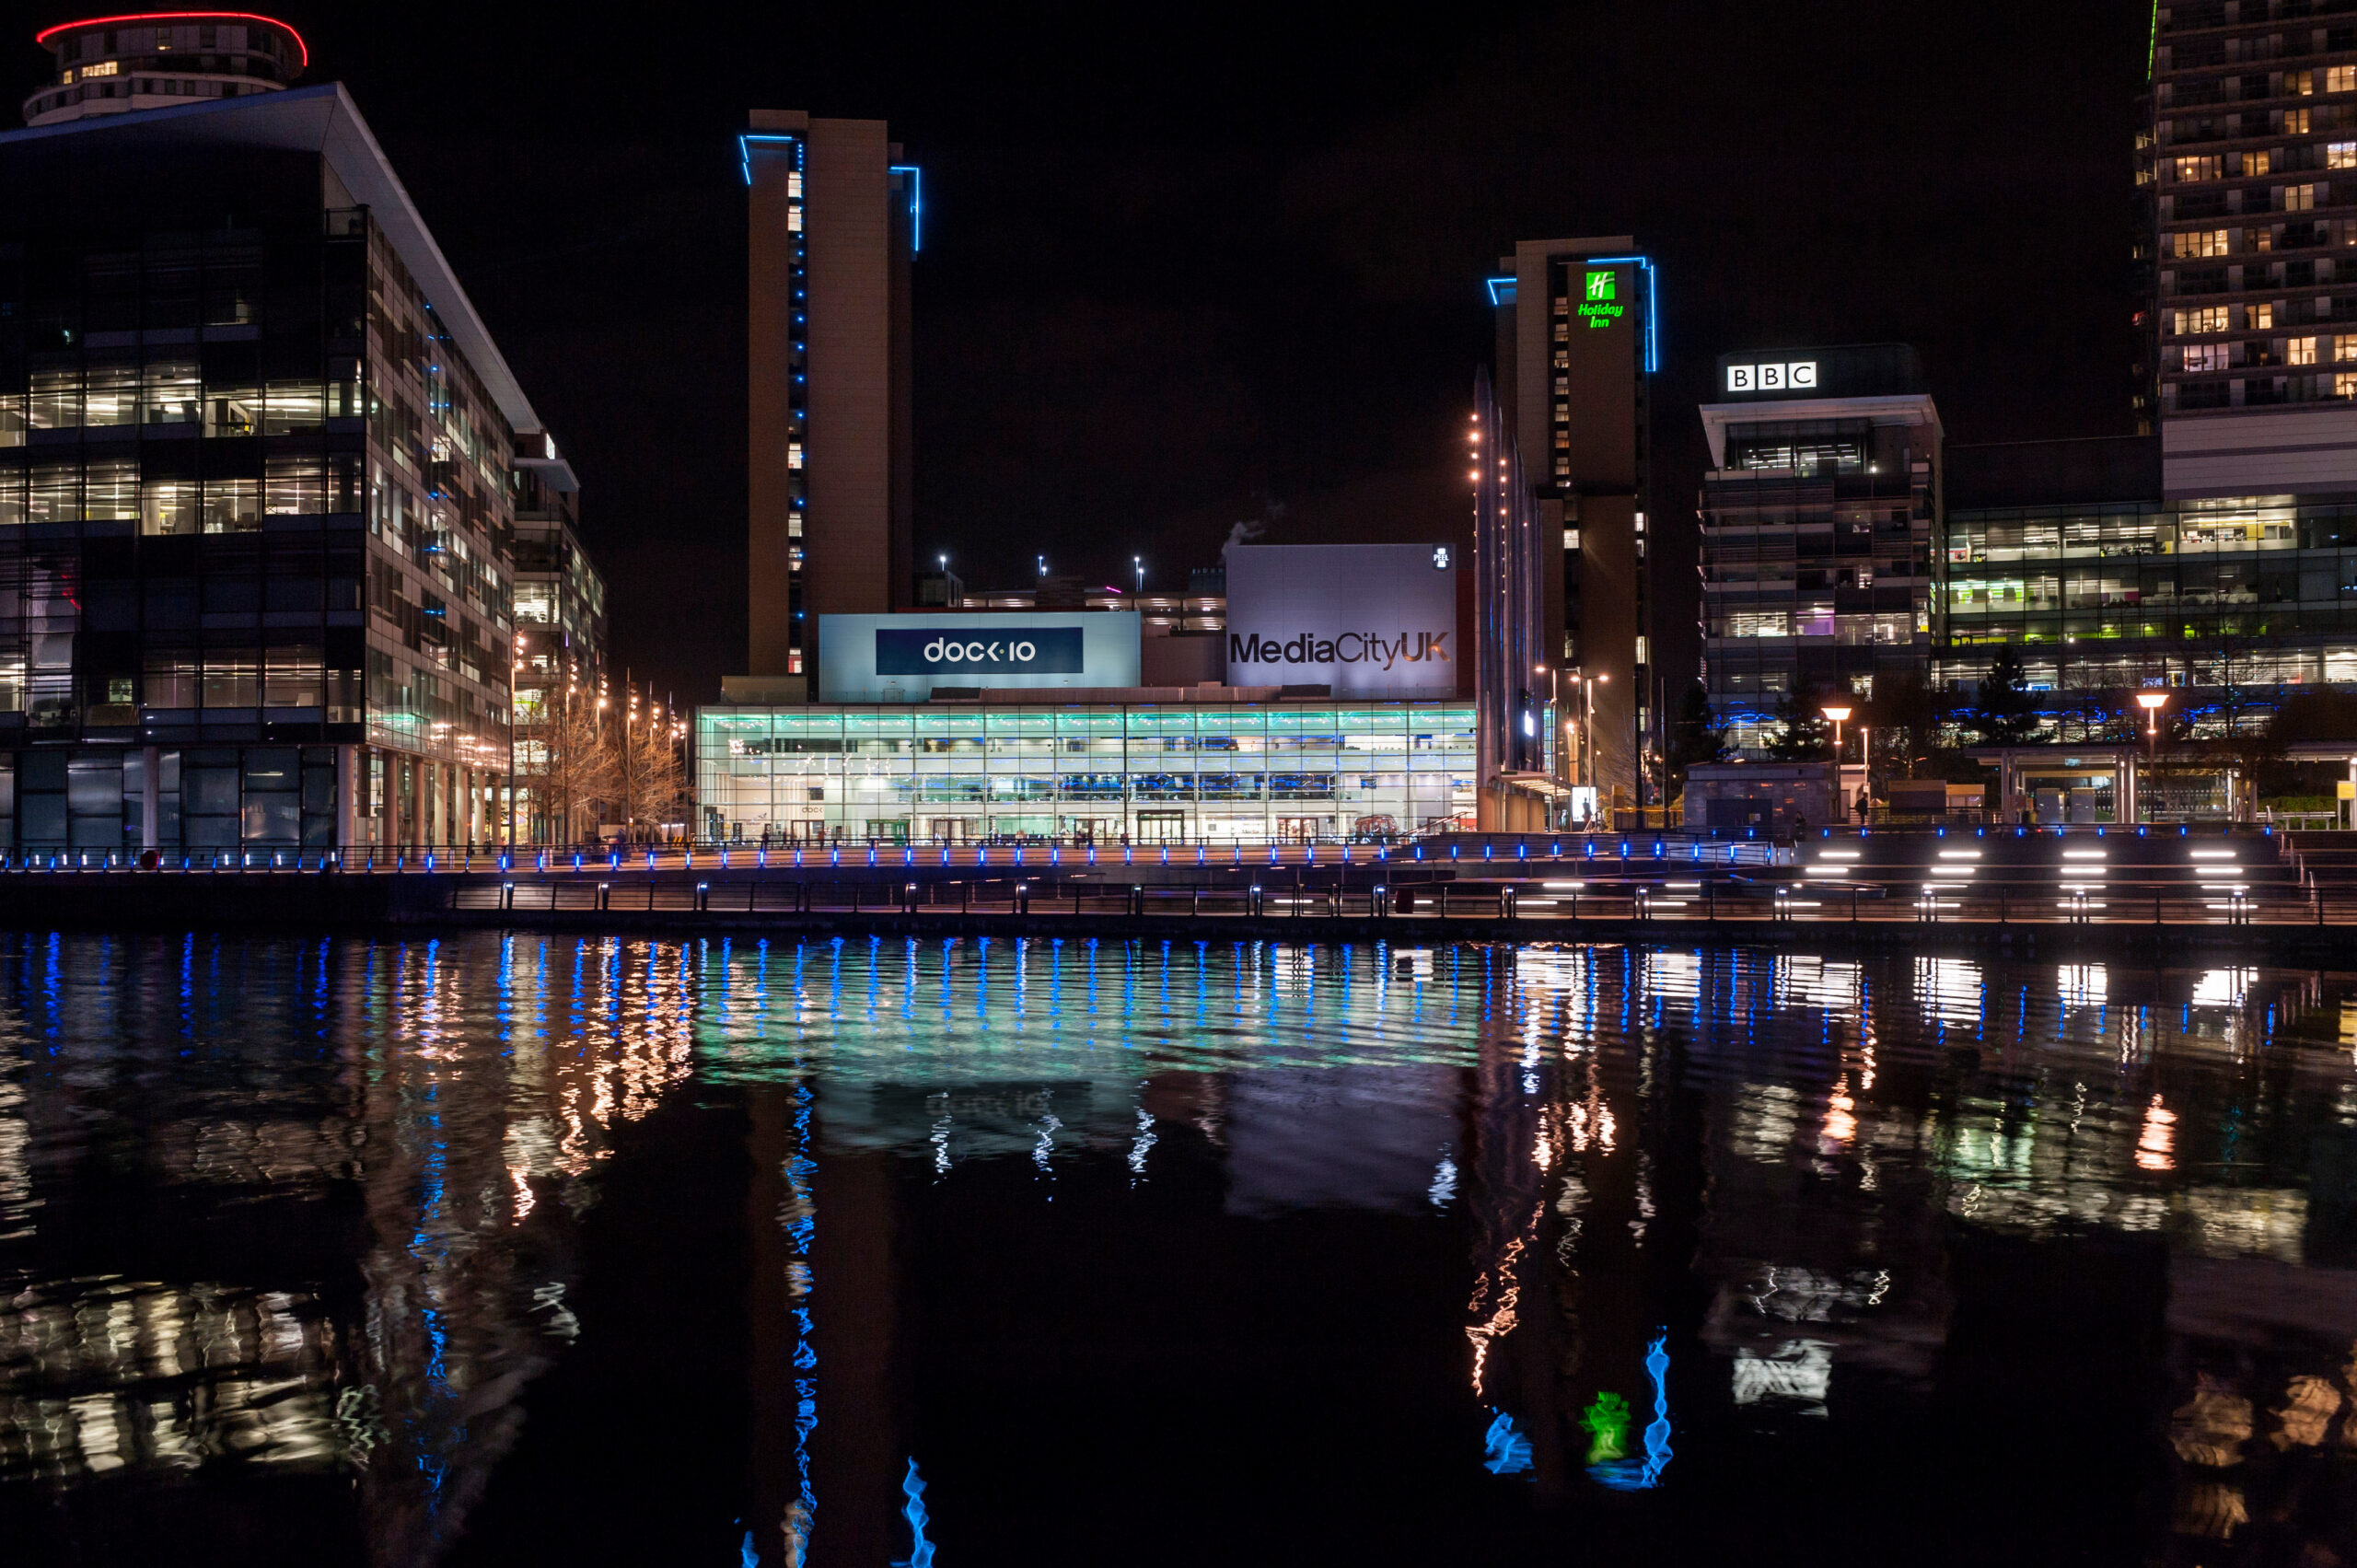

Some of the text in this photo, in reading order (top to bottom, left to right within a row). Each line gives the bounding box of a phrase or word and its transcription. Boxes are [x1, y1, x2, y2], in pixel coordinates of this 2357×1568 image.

[1577, 302, 1623, 318] Holiday
[1590, 315, 1609, 329] Inn
[1732, 365, 1814, 389] BBC
[1433, 553, 1450, 562] PEEL
[1230, 632, 1451, 671] MediaCityUK
